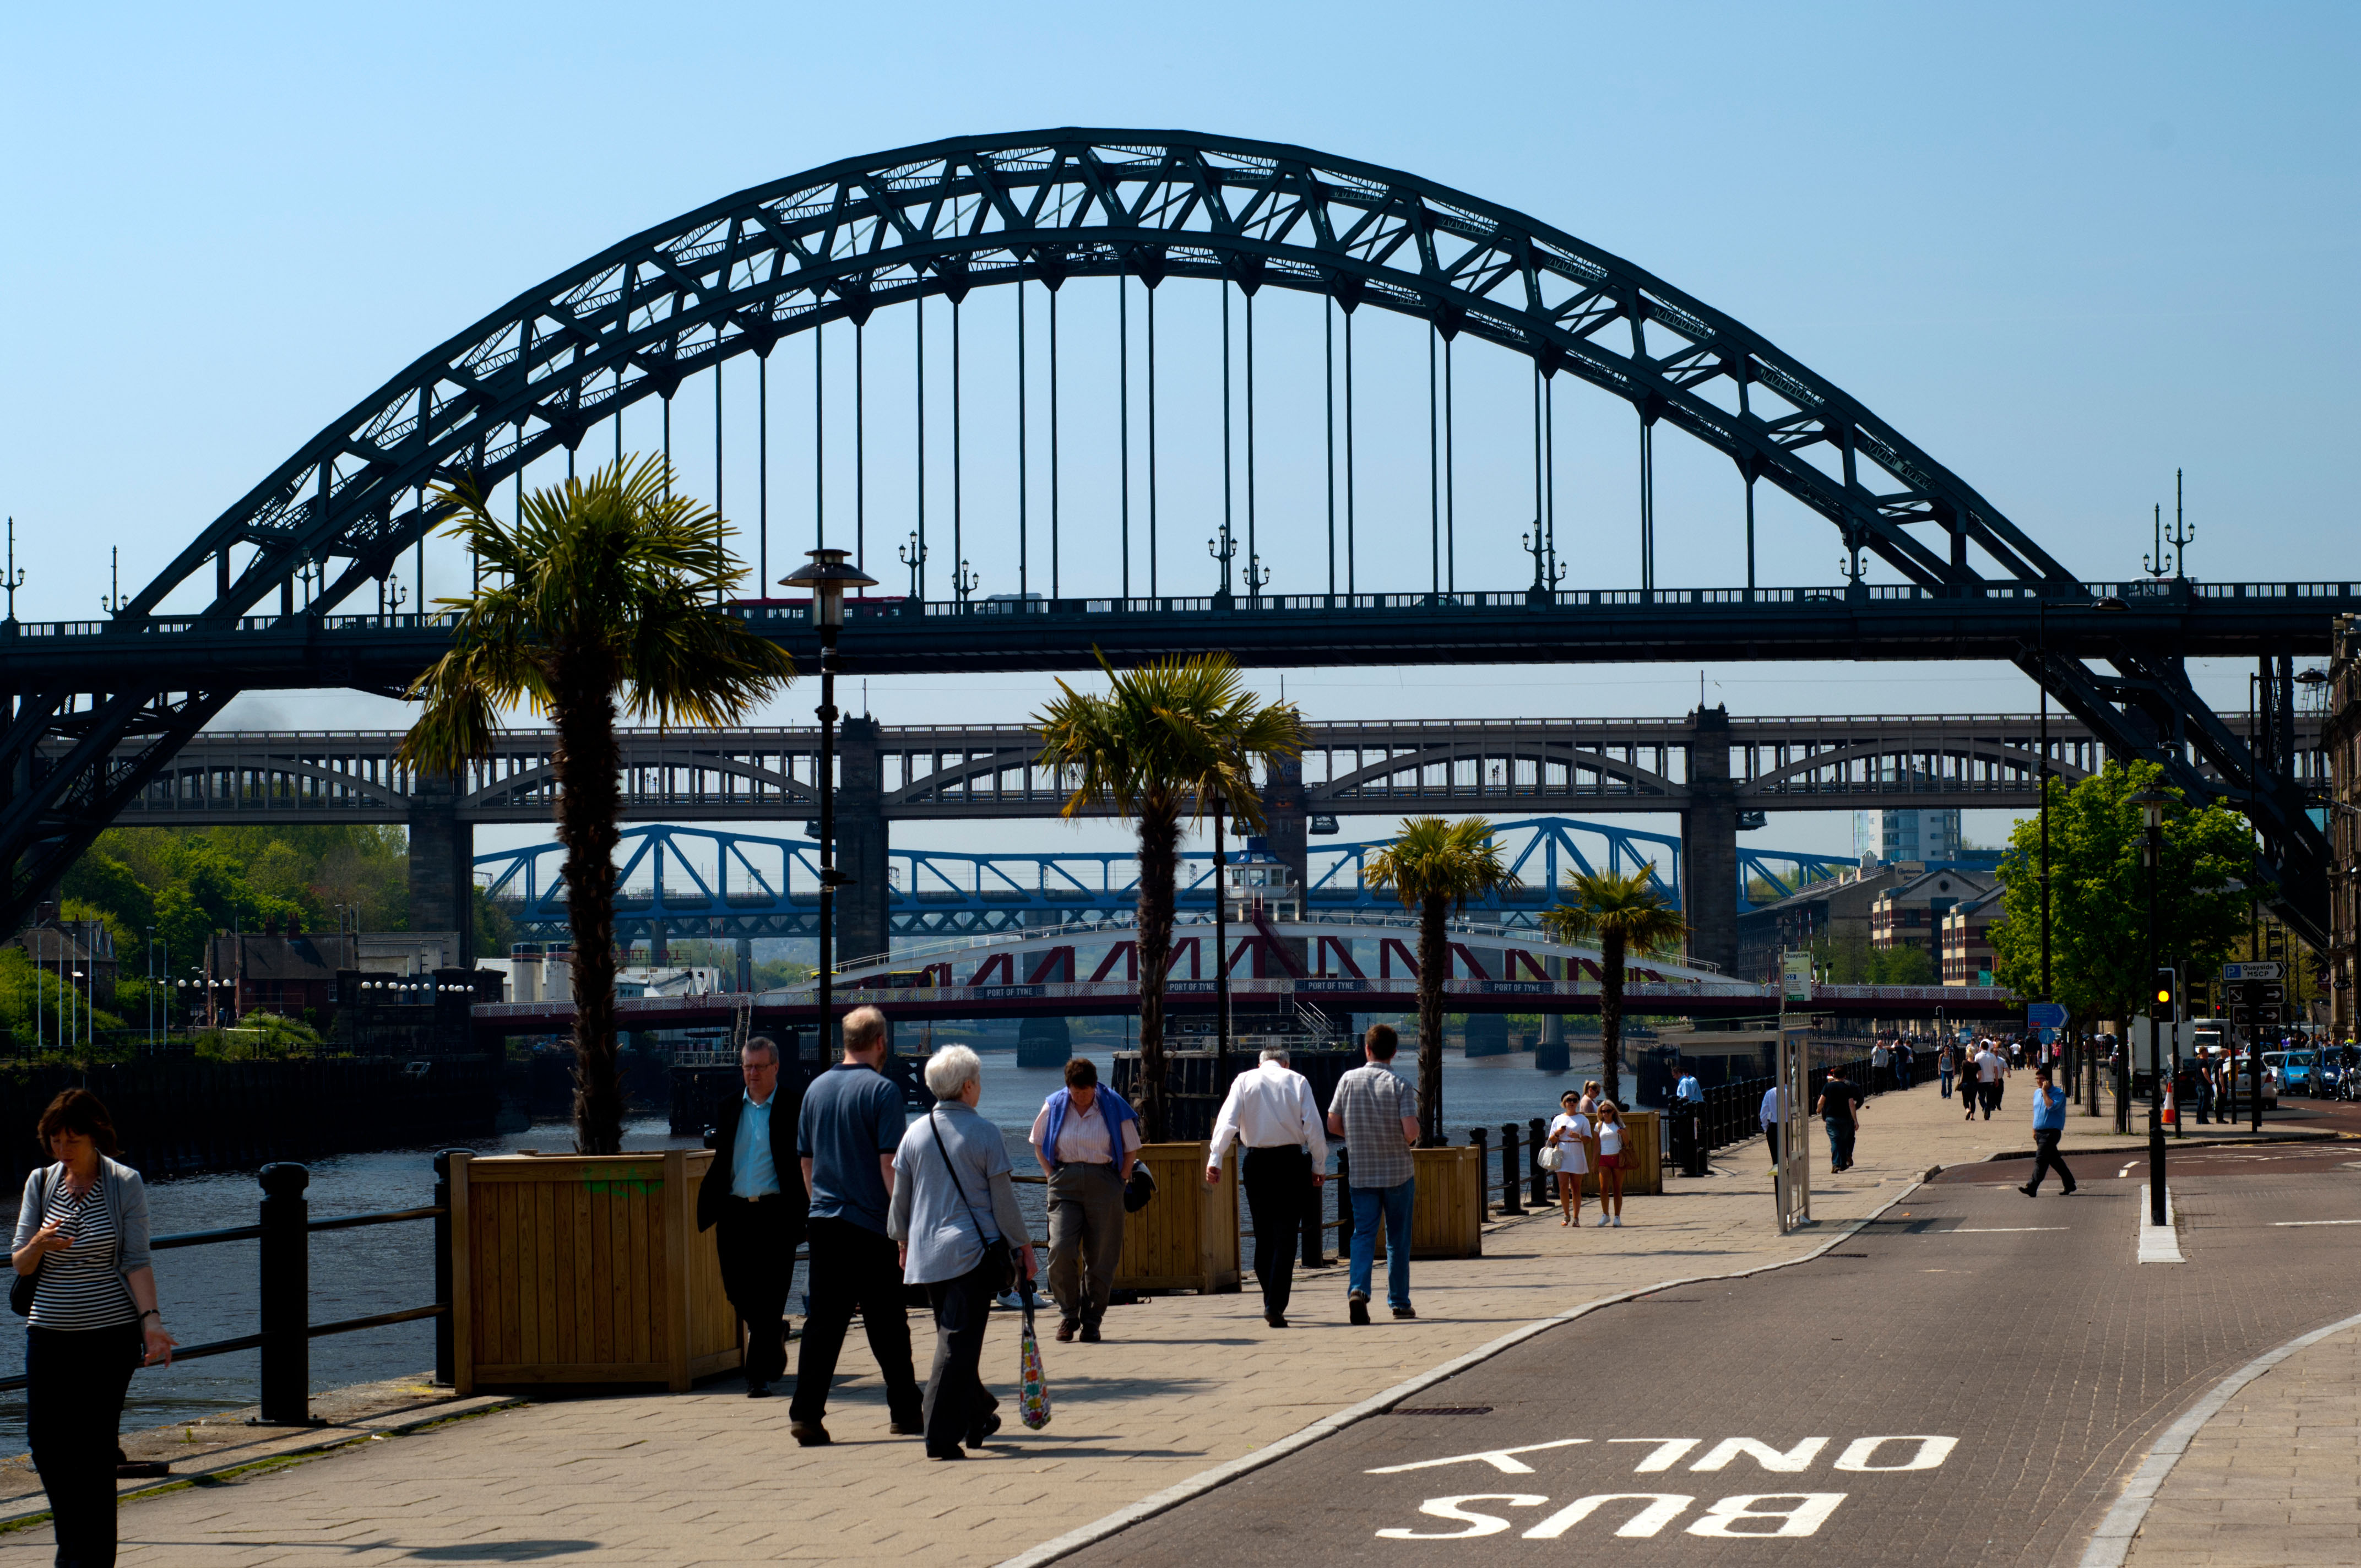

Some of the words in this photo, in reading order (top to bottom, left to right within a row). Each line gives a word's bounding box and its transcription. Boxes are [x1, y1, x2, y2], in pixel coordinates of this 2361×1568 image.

[2227, 967, 2235, 977] P
[987, 988, 1004, 997] PORT
[1006, 988, 1014, 996] OF
[1016, 987, 1033, 996] TYNE
[1170, 983, 1187, 991] PORT
[1494, 983, 1512, 991] PORT
[1364, 1435, 1959, 1474] ONLY
[1375, 1493, 1848, 1539] BUS
